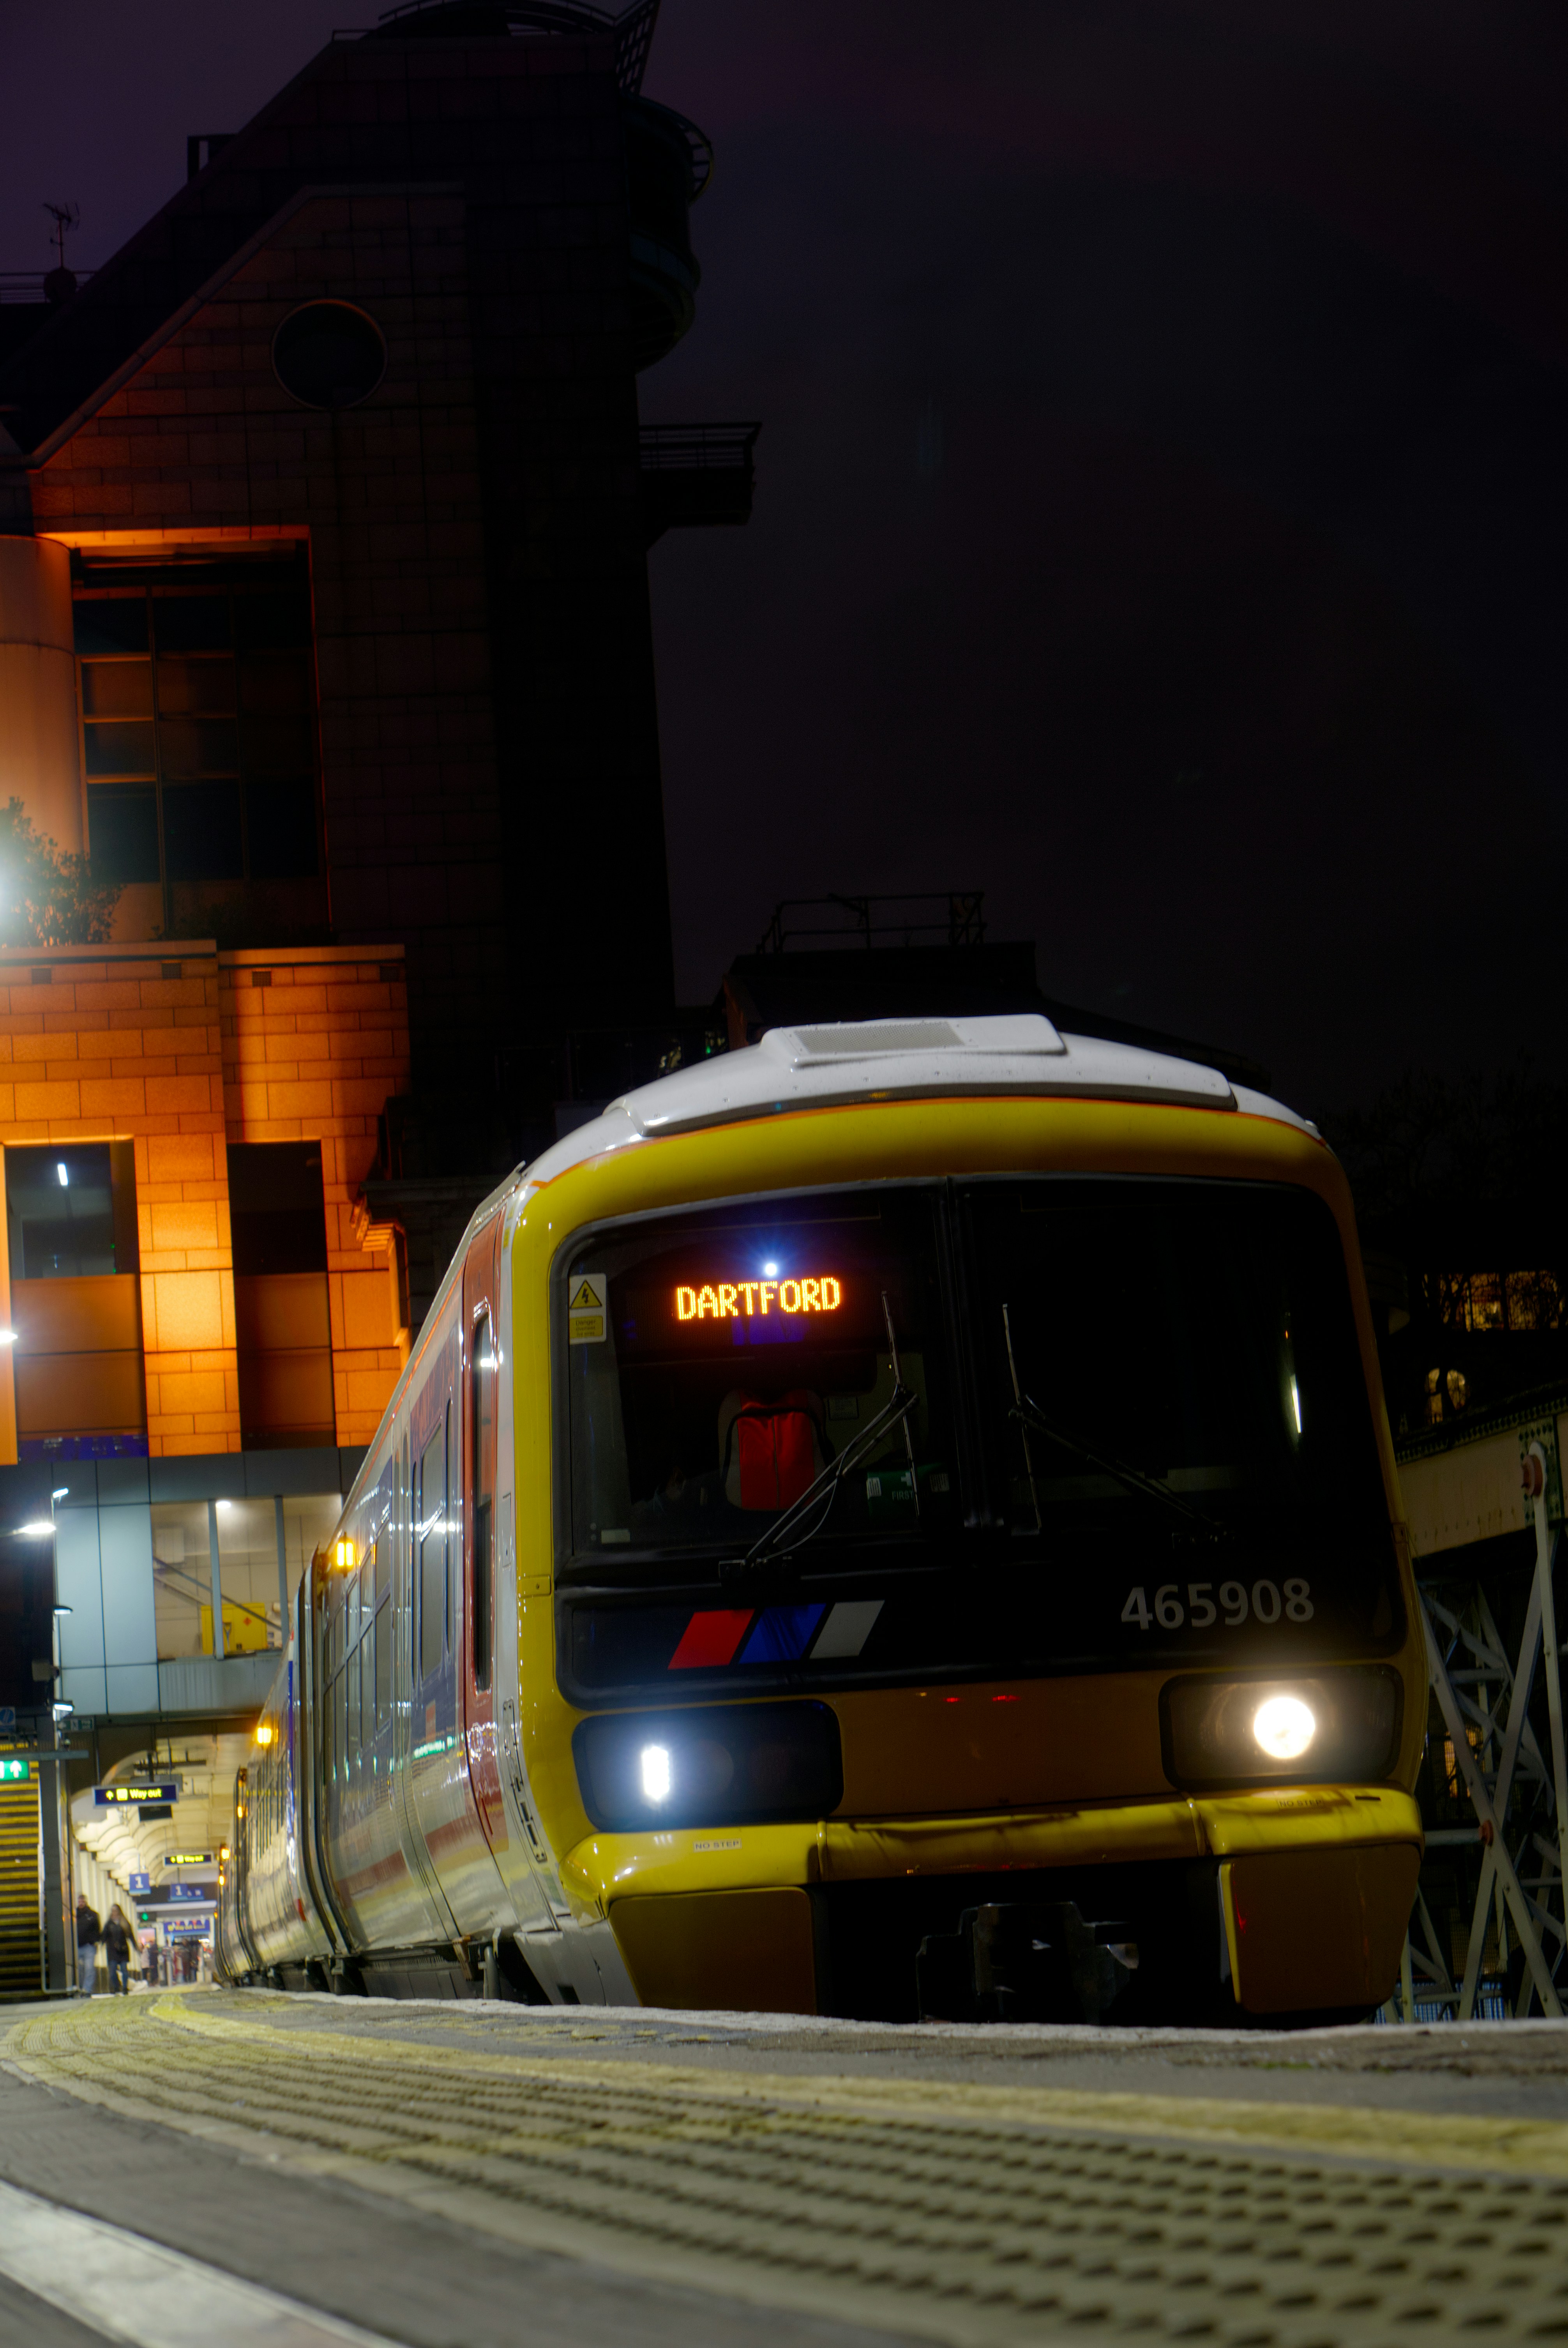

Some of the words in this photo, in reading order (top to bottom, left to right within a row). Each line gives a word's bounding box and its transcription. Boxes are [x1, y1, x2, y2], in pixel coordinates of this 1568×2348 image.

[677, 1277, 840, 1320] DARTFORD
[1121, 1577, 1314, 1630] 465908
[129, 1789, 147, 1800] Way
[148, 1788, 162, 1798] out
[713, 1841, 739, 1849] STEP
[135, 1876, 143, 1888] 1
[175, 1885, 182, 1896] 1
